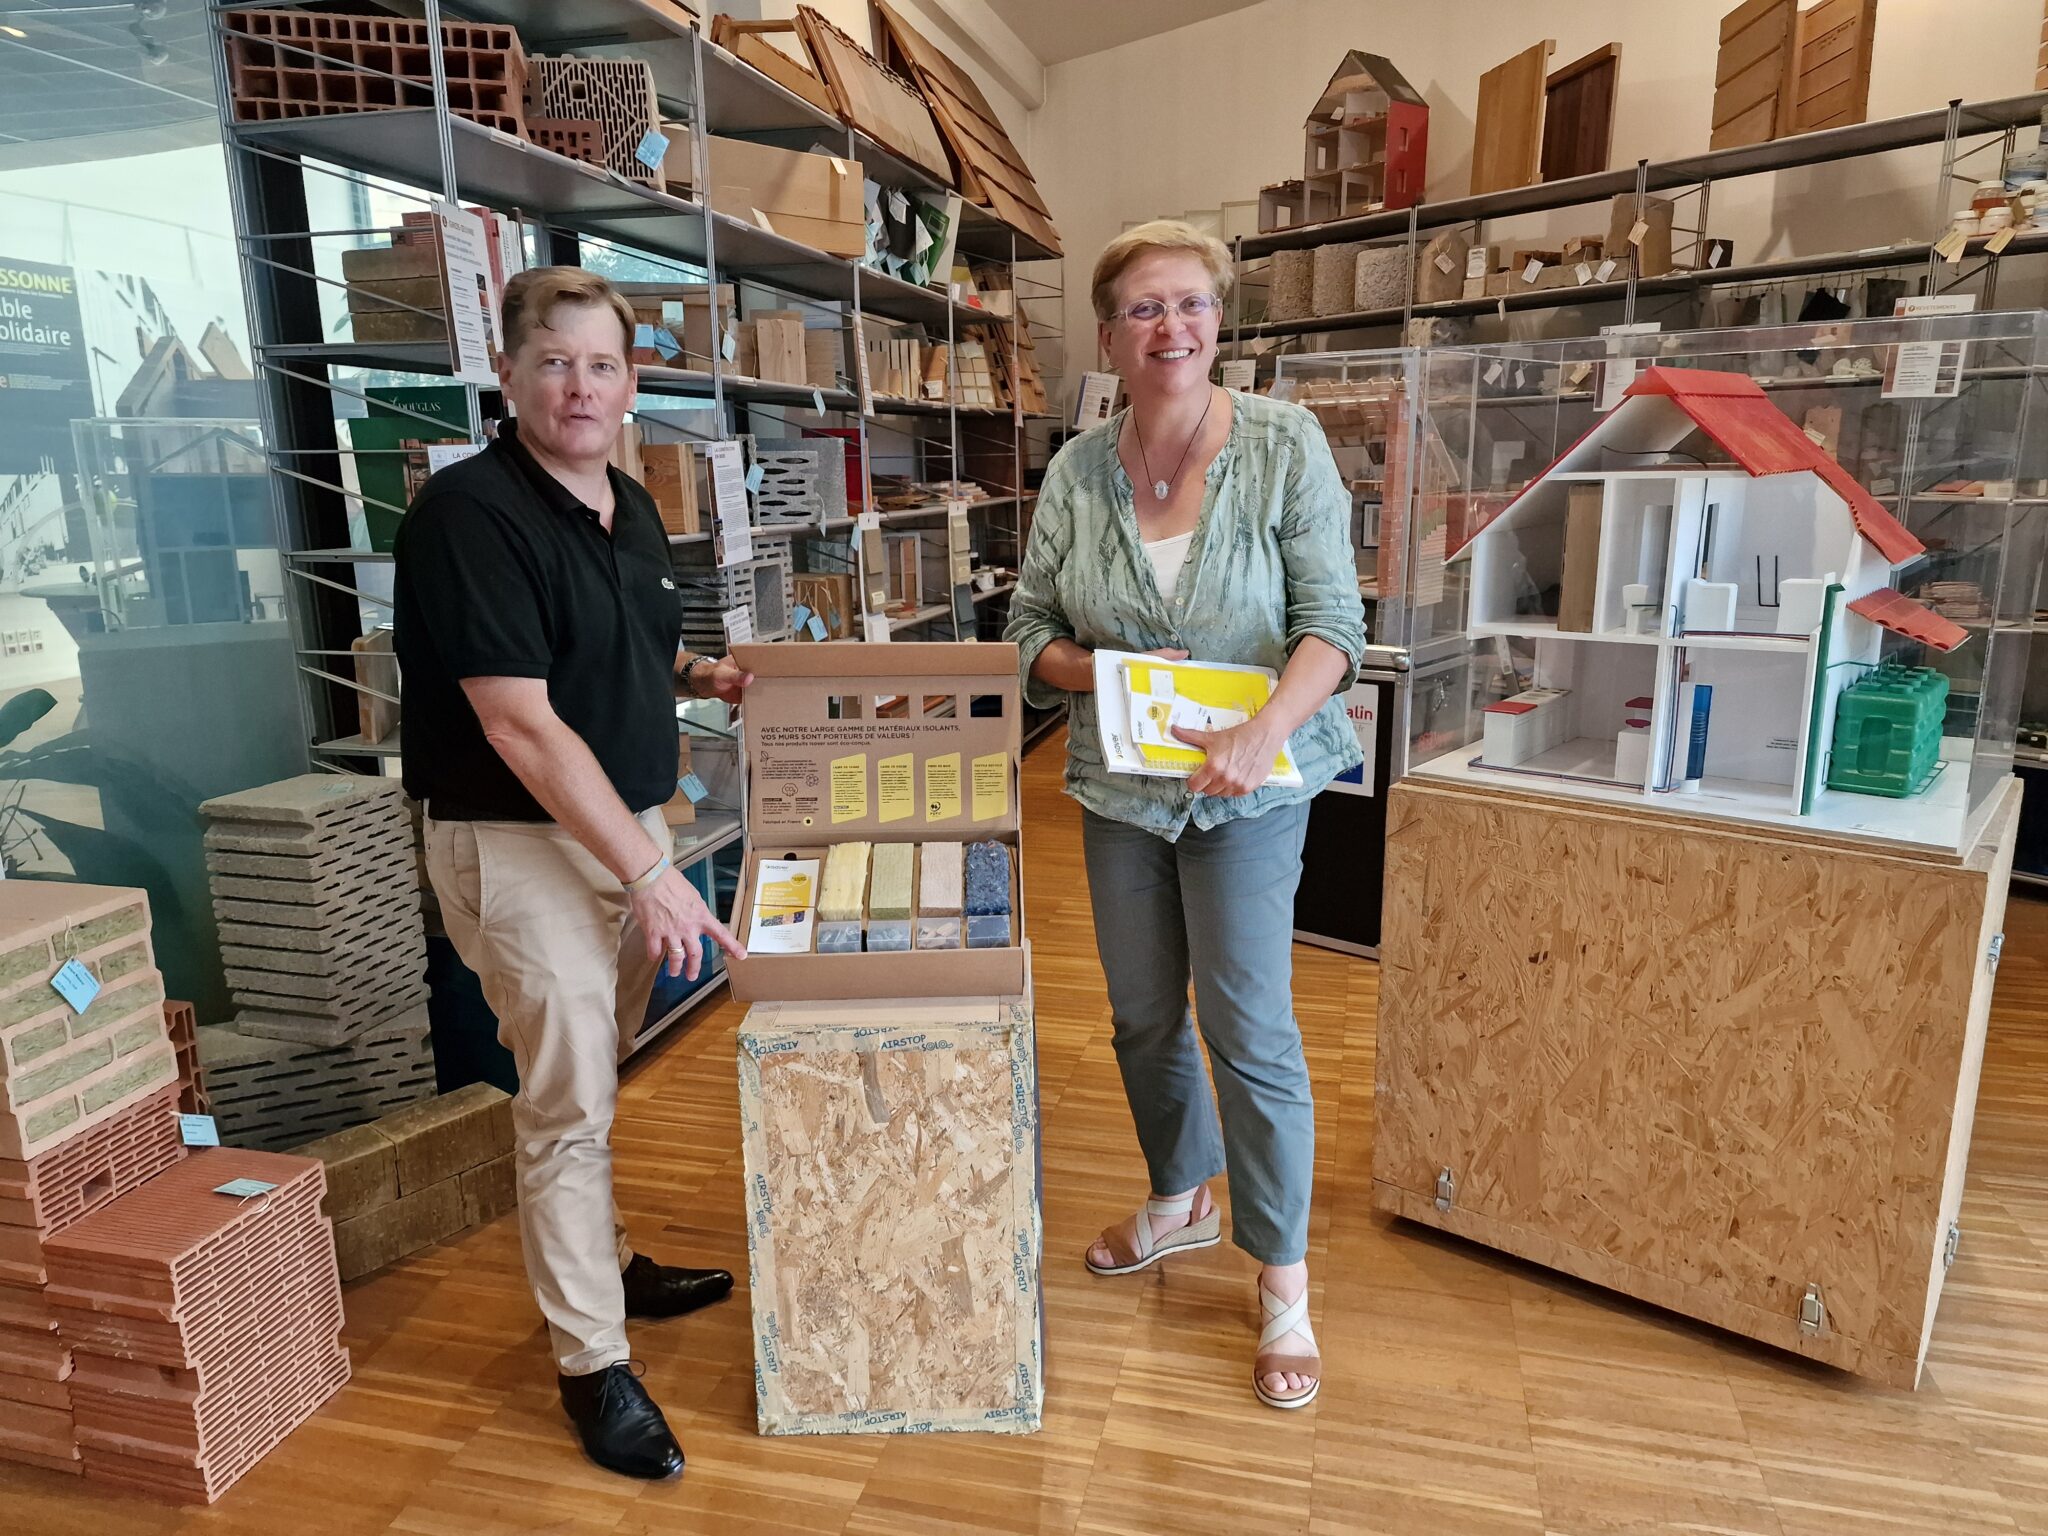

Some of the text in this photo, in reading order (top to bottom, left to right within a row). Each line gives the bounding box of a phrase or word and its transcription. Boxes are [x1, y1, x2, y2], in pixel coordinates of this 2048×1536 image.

[0, 296, 33, 320] ble
[878, 724, 921, 732] MATÉRIAUX
[1110, 731, 1123, 757] isover
[753, 1039, 800, 1057] AIRSTOP
[880, 1034, 927, 1050] AIRSTOP
[756, 1173, 773, 1215] AIRSTOP
[1013, 1253, 1029, 1293] AIRSTOP
[761, 1334, 779, 1374] AIRSTOP
[1017, 1362, 1034, 1401] AIRSTOP
[864, 1410, 907, 1426] AIRSTOP
